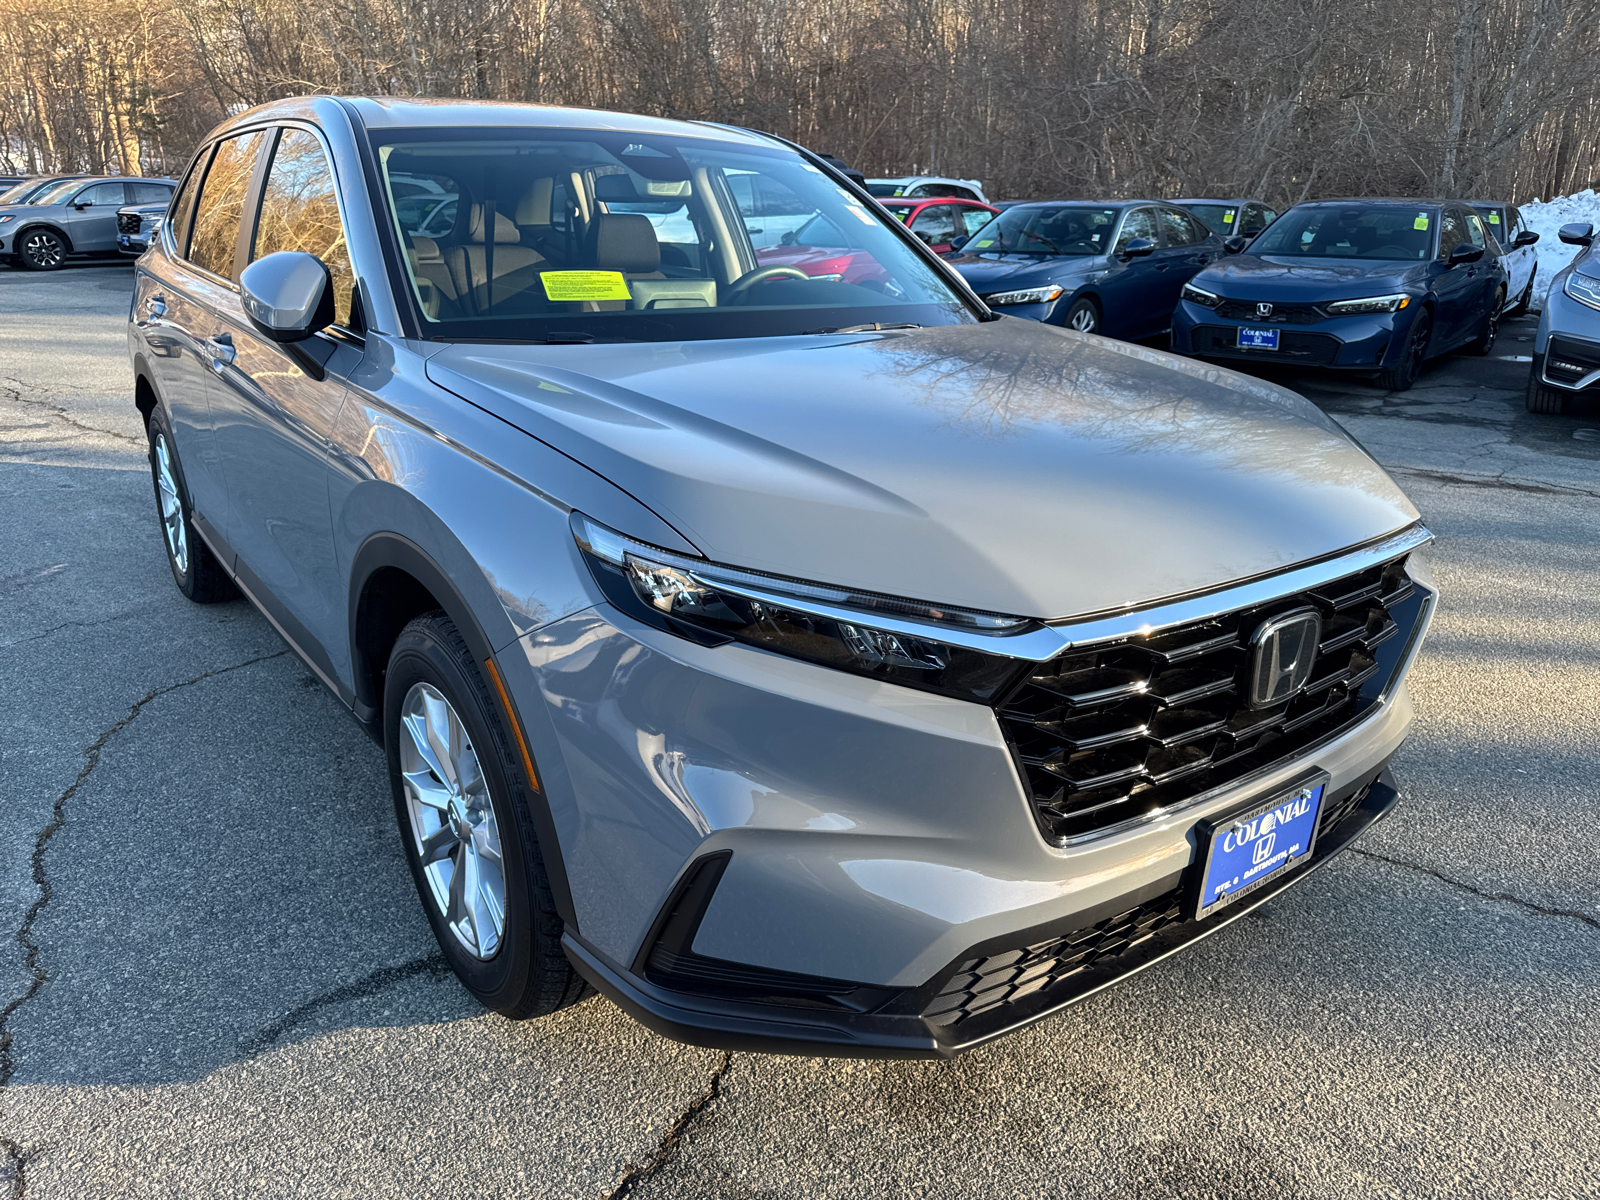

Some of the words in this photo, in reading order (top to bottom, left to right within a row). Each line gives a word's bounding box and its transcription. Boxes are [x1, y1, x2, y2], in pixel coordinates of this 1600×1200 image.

[1243, 328, 1274, 337] COLONIAL
[1223, 798, 1310, 853] COLONIAL
[1214, 880, 1232, 894] RTE.
[1232, 876, 1239, 885] 6
[1243, 850, 1288, 880] DARTMOUTH,
[1289, 843, 1300, 854] MA
